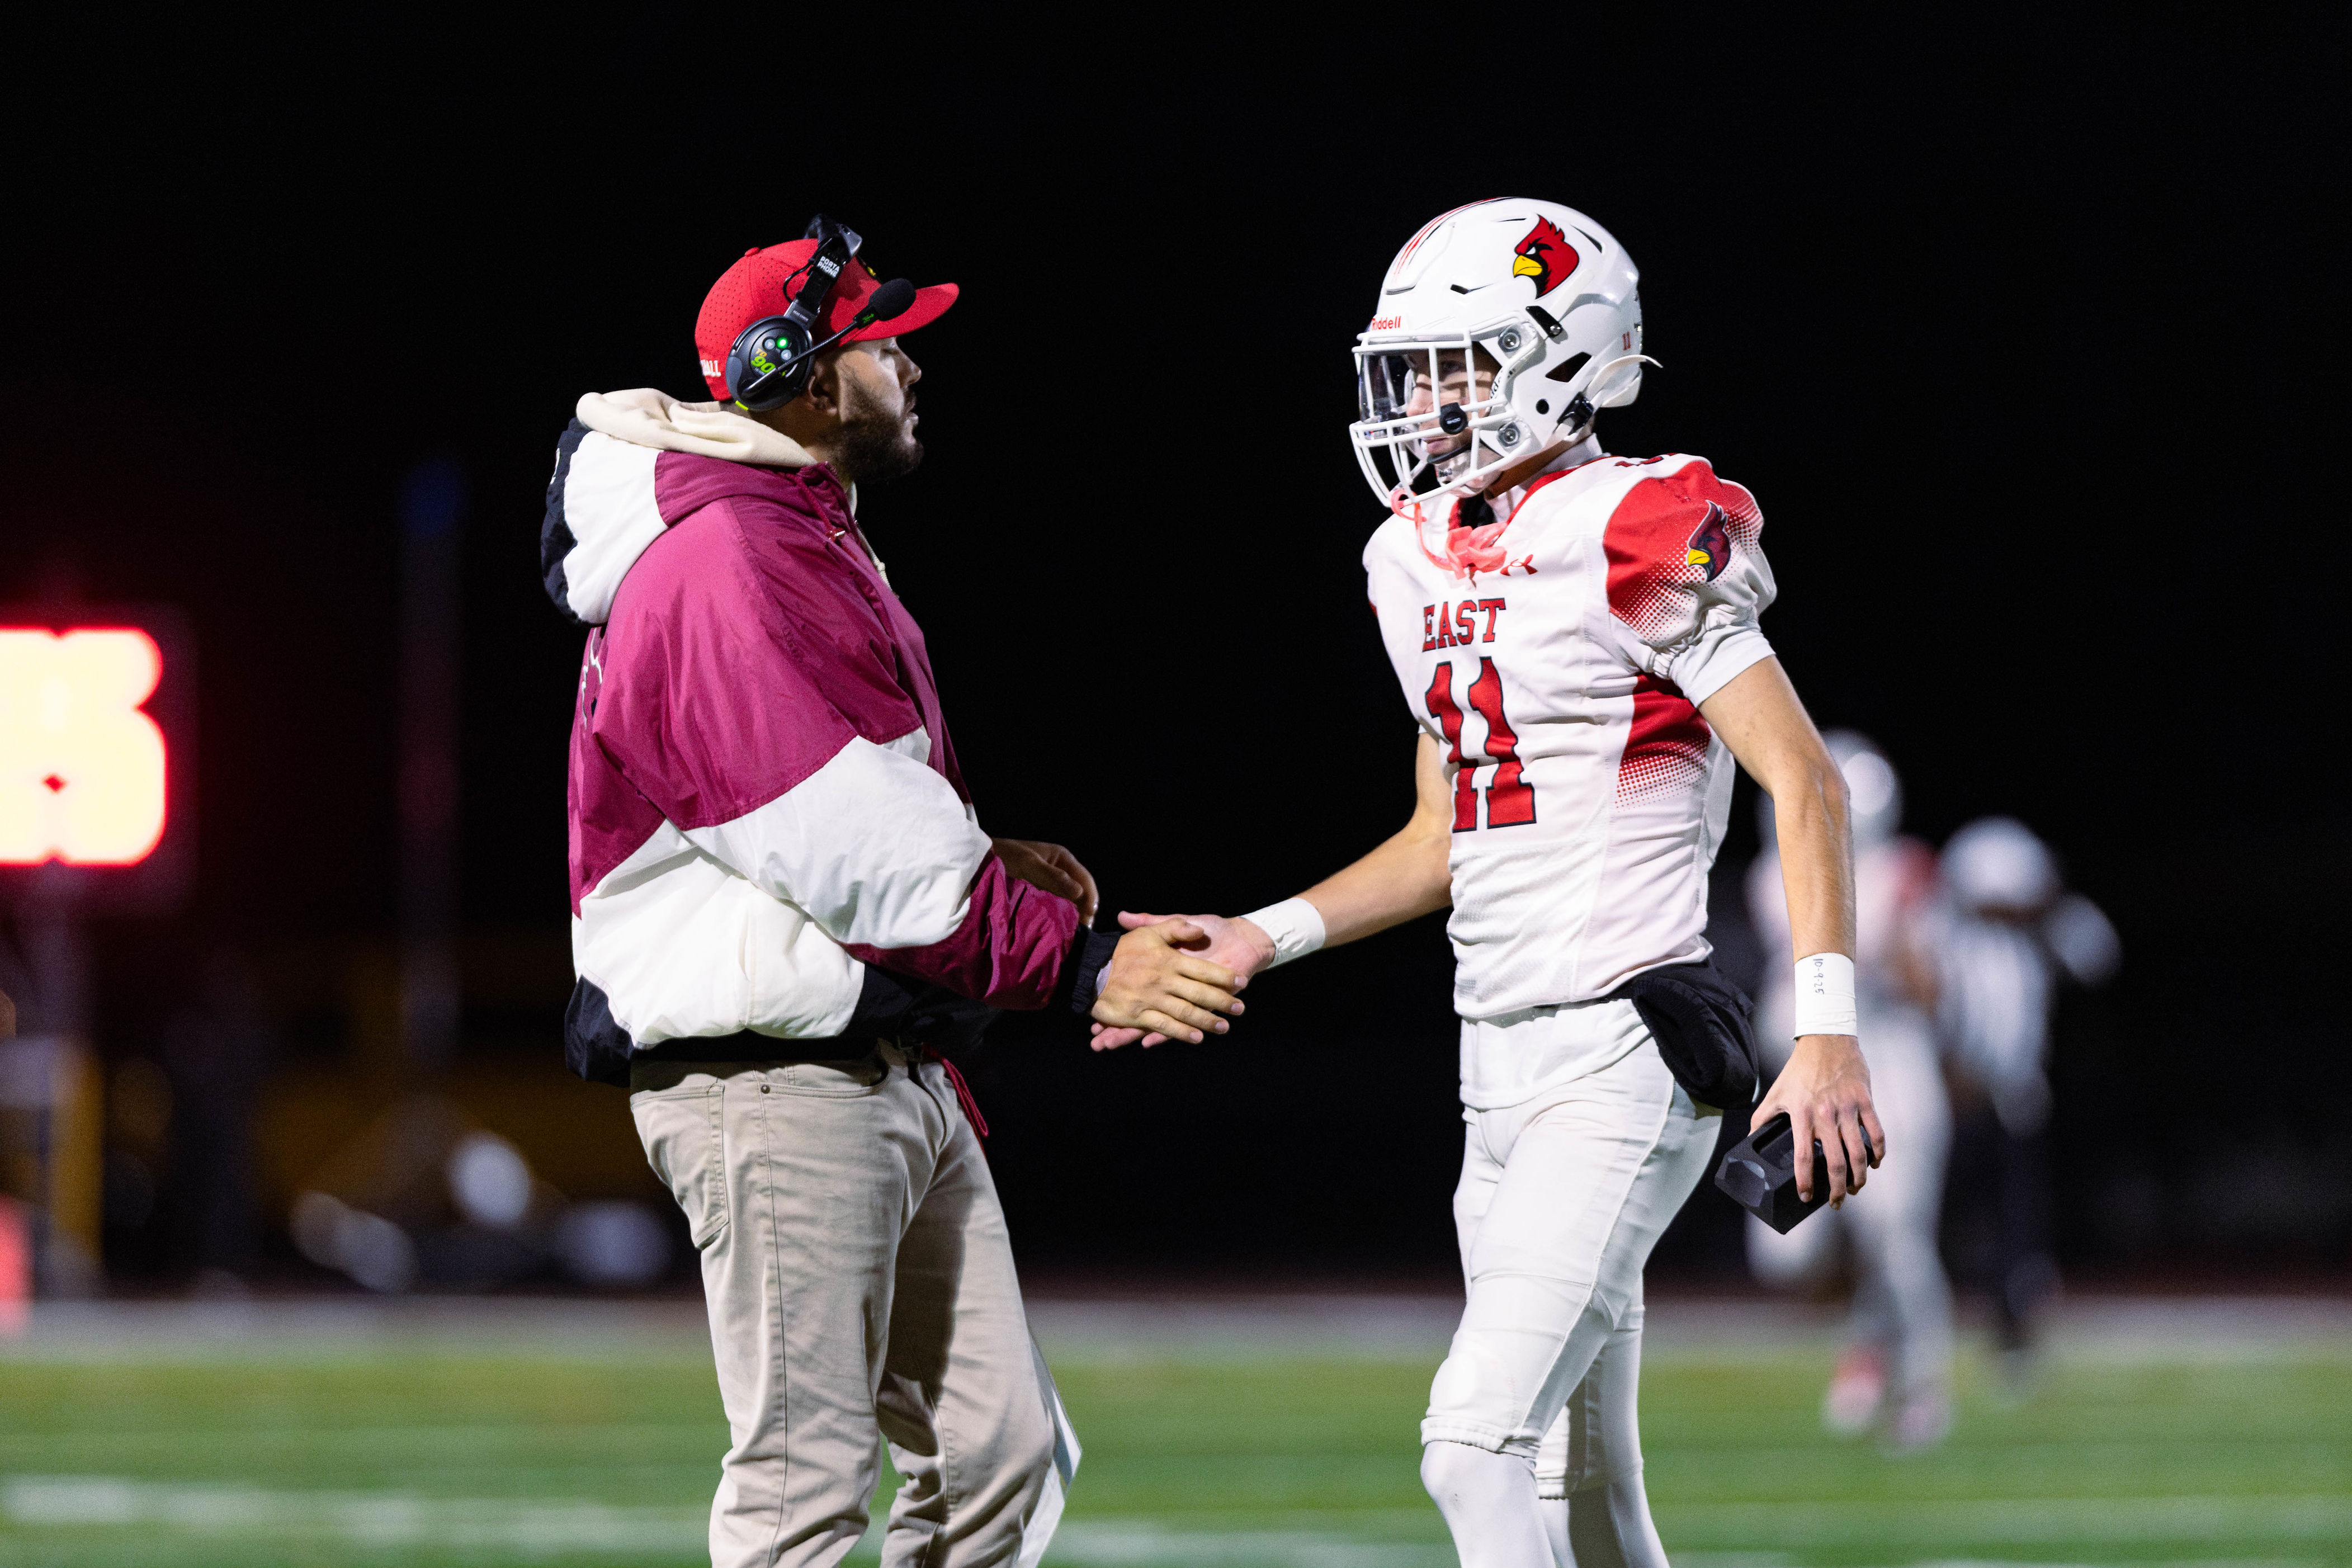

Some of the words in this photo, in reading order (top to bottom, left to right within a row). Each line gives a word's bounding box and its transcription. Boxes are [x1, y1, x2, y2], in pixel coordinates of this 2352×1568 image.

[817, 261, 838, 278] PHONE
[820, 256, 839, 272] PORTA
[1422, 597, 1506, 653] EAST
[1425, 655, 1537, 833] 11
